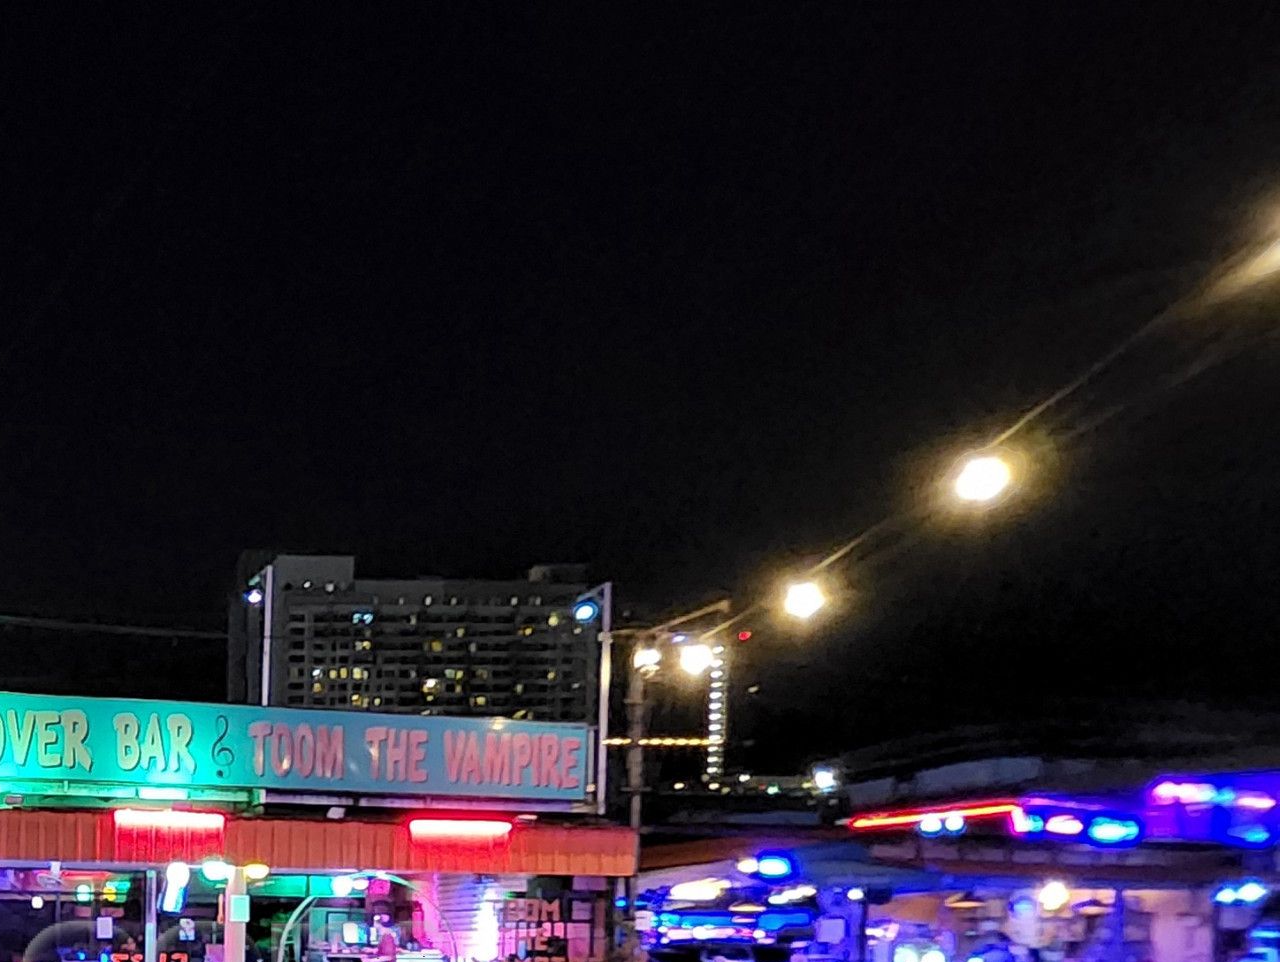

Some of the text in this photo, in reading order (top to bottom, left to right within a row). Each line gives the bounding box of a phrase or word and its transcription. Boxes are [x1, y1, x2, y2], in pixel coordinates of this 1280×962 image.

[113, 712, 197, 774] BAR
[248, 721, 581, 790] TOOM THE VAMPIRE
